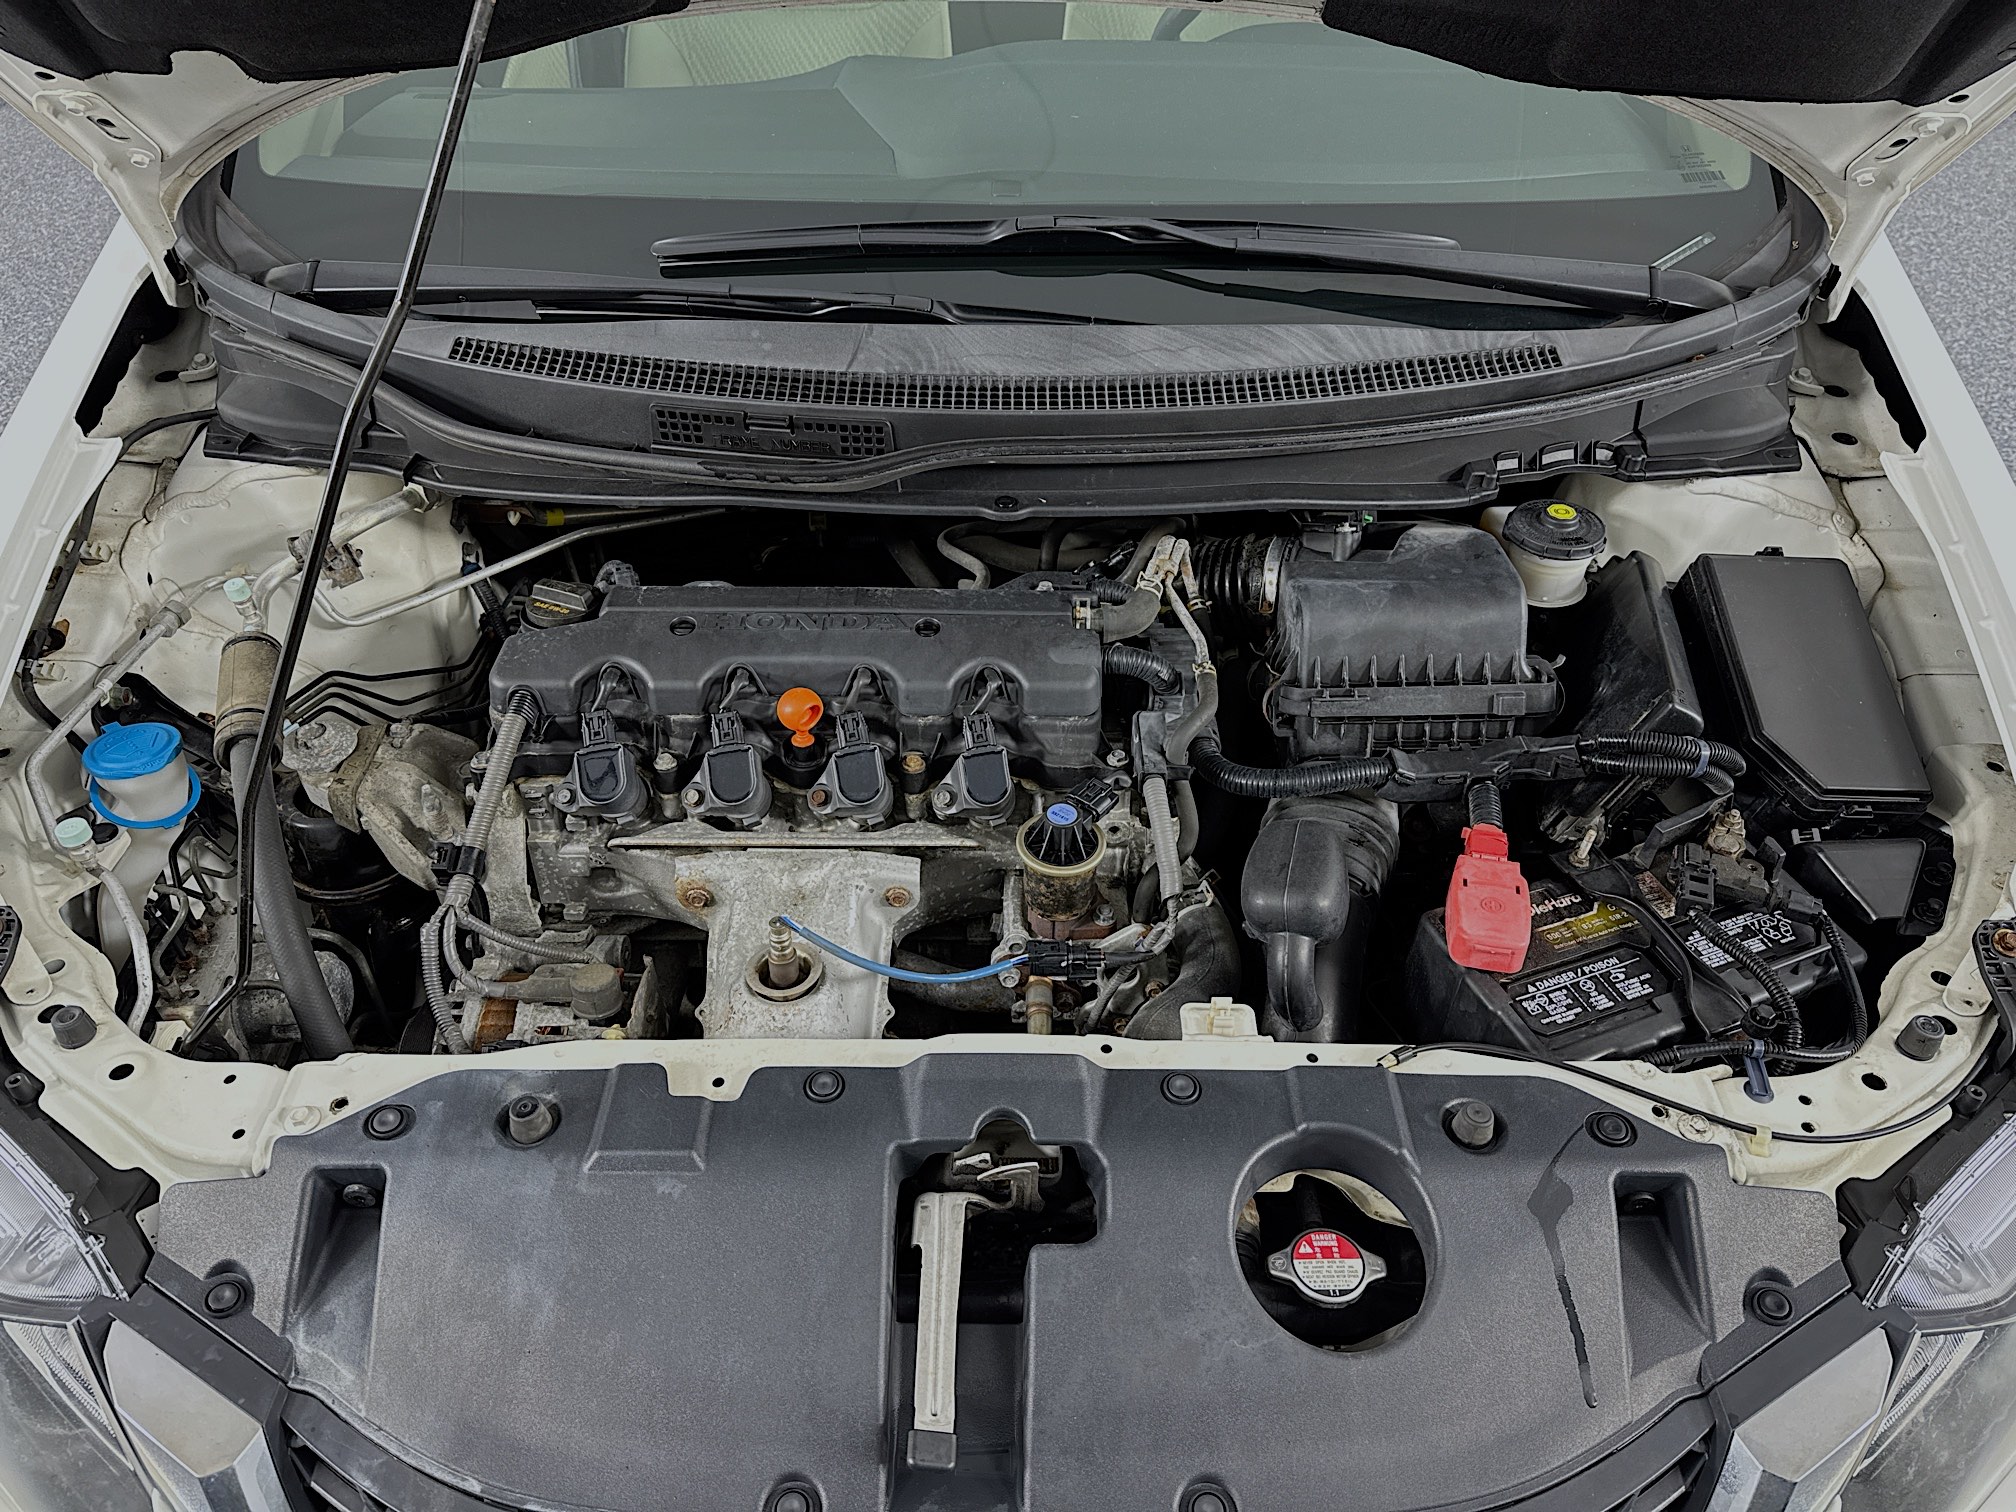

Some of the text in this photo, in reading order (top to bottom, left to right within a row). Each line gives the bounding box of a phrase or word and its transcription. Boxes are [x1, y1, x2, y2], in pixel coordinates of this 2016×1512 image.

[712, 433, 832, 453] FRAME NUMBER
[701, 612, 912, 631] HONDA
[1535, 971, 1577, 990] DANGER
[1583, 956, 1620, 975] POISON
[1311, 1233, 1337, 1241] DANGER
